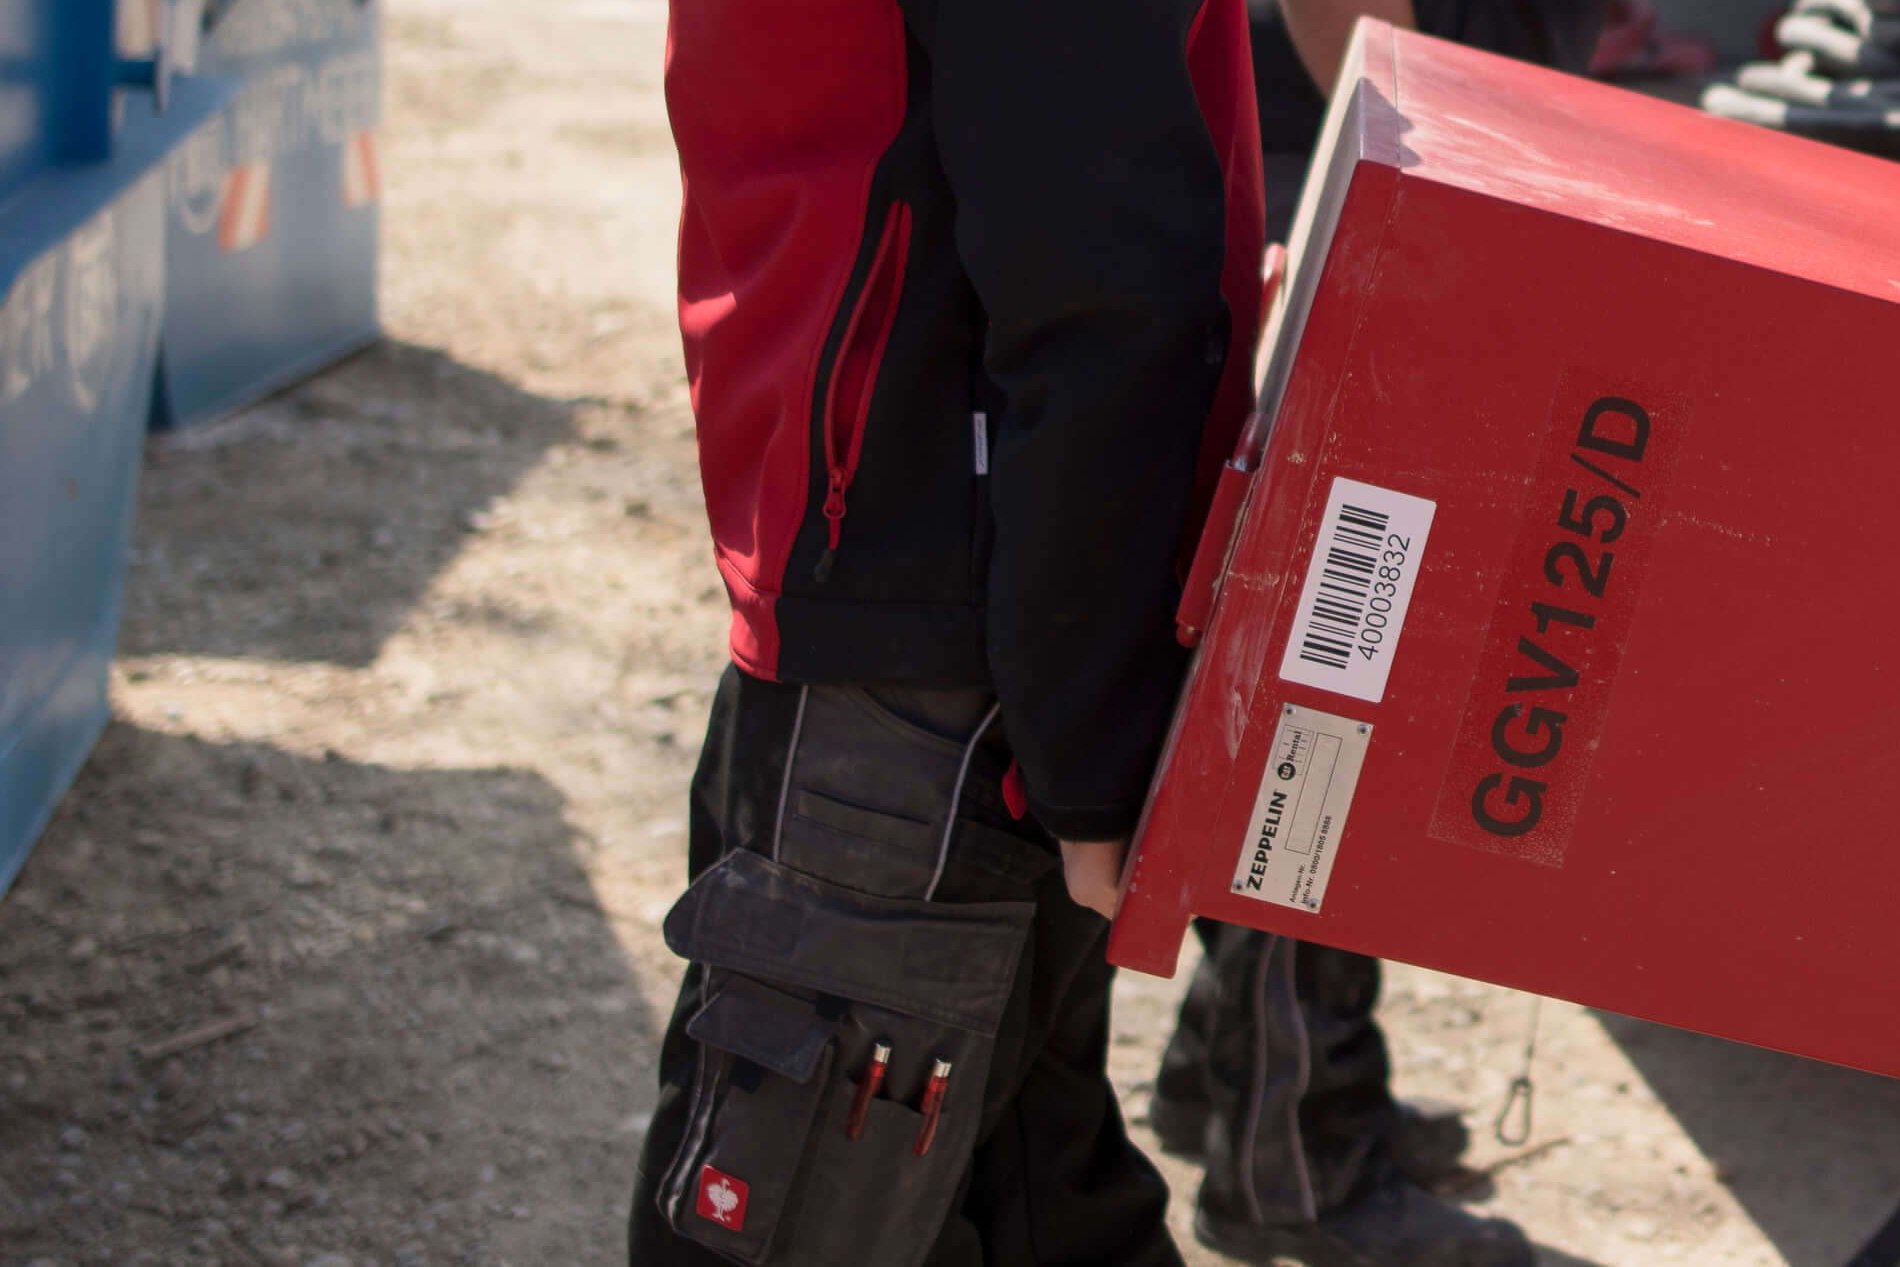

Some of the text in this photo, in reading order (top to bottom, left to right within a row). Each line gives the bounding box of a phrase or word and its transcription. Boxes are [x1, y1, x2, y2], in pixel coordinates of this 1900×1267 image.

[1358, 533, 1411, 662] 40003832
[1471, 395, 1651, 837] GGV125/D
[1246, 790, 1288, 892] ZEPPELIN
[1286, 730, 1303, 762] Rental
